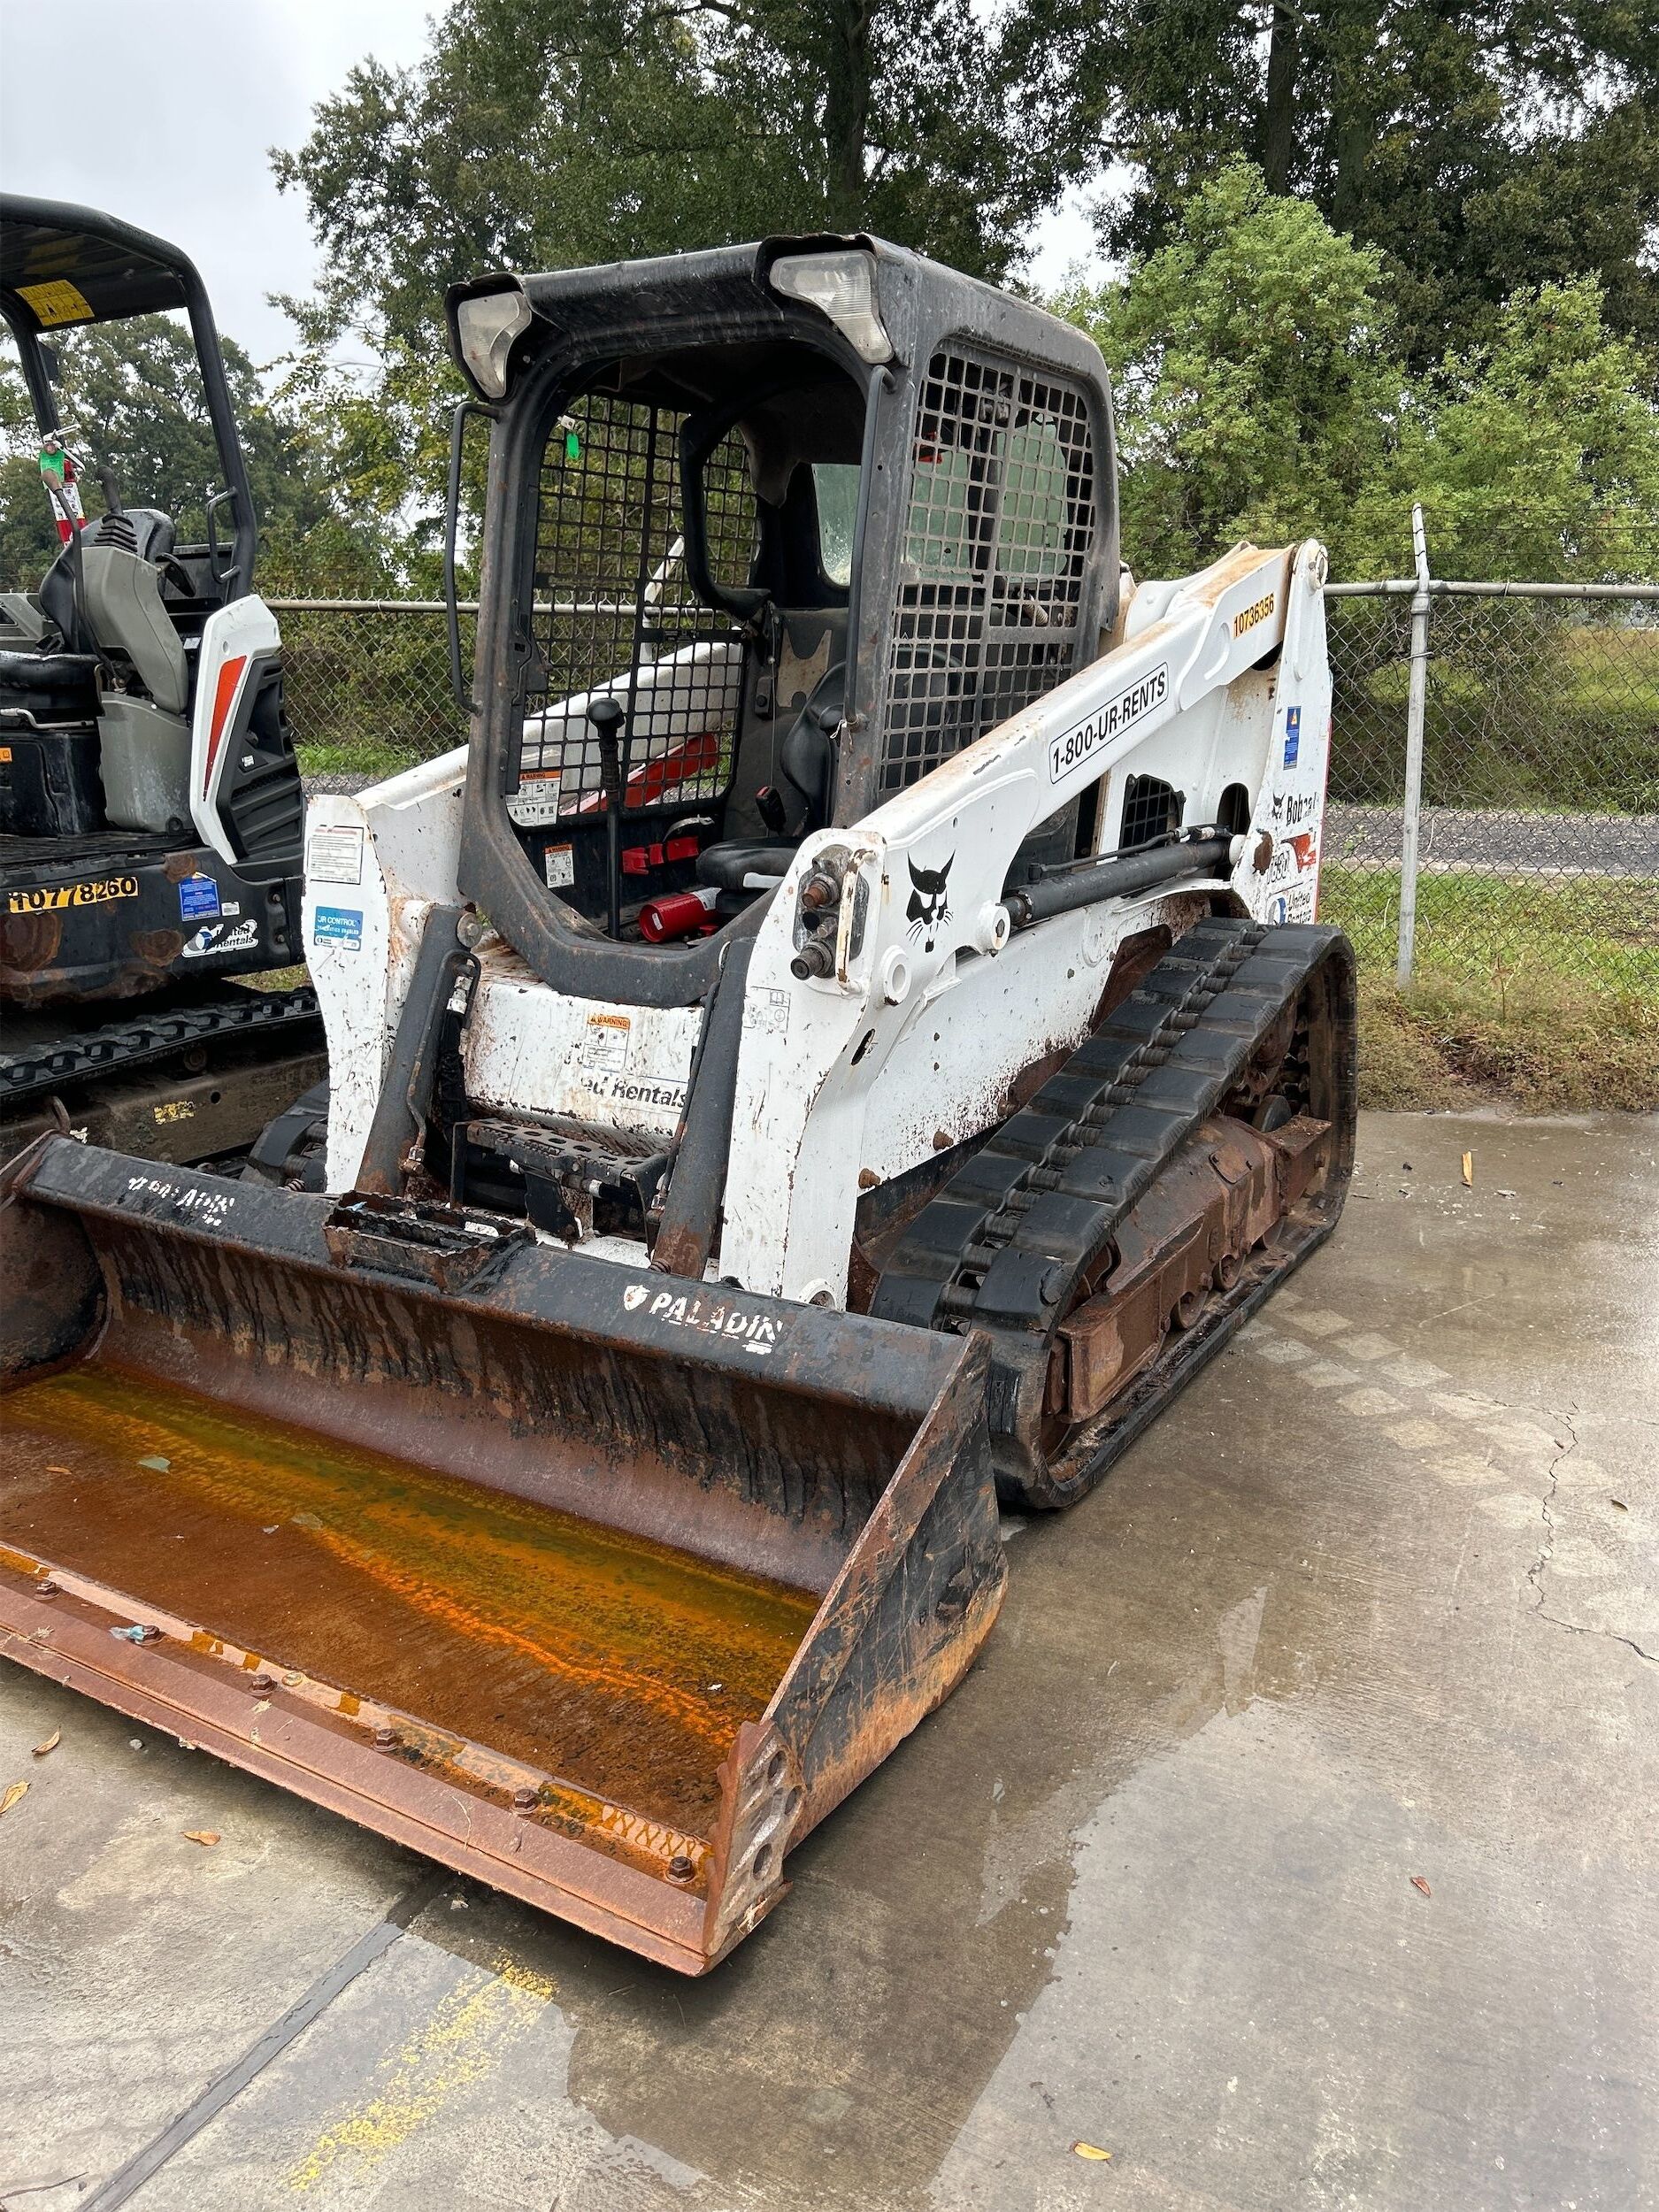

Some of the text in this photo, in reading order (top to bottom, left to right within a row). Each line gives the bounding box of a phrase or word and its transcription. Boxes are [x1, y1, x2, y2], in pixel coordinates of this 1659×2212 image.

[1234, 593, 1274, 637] 10736356
[1053, 671, 1165, 774] 1-800-UR-RENTS
[12, 877, 137, 911] 10778260
[597, 1015, 627, 1027] WARNING
